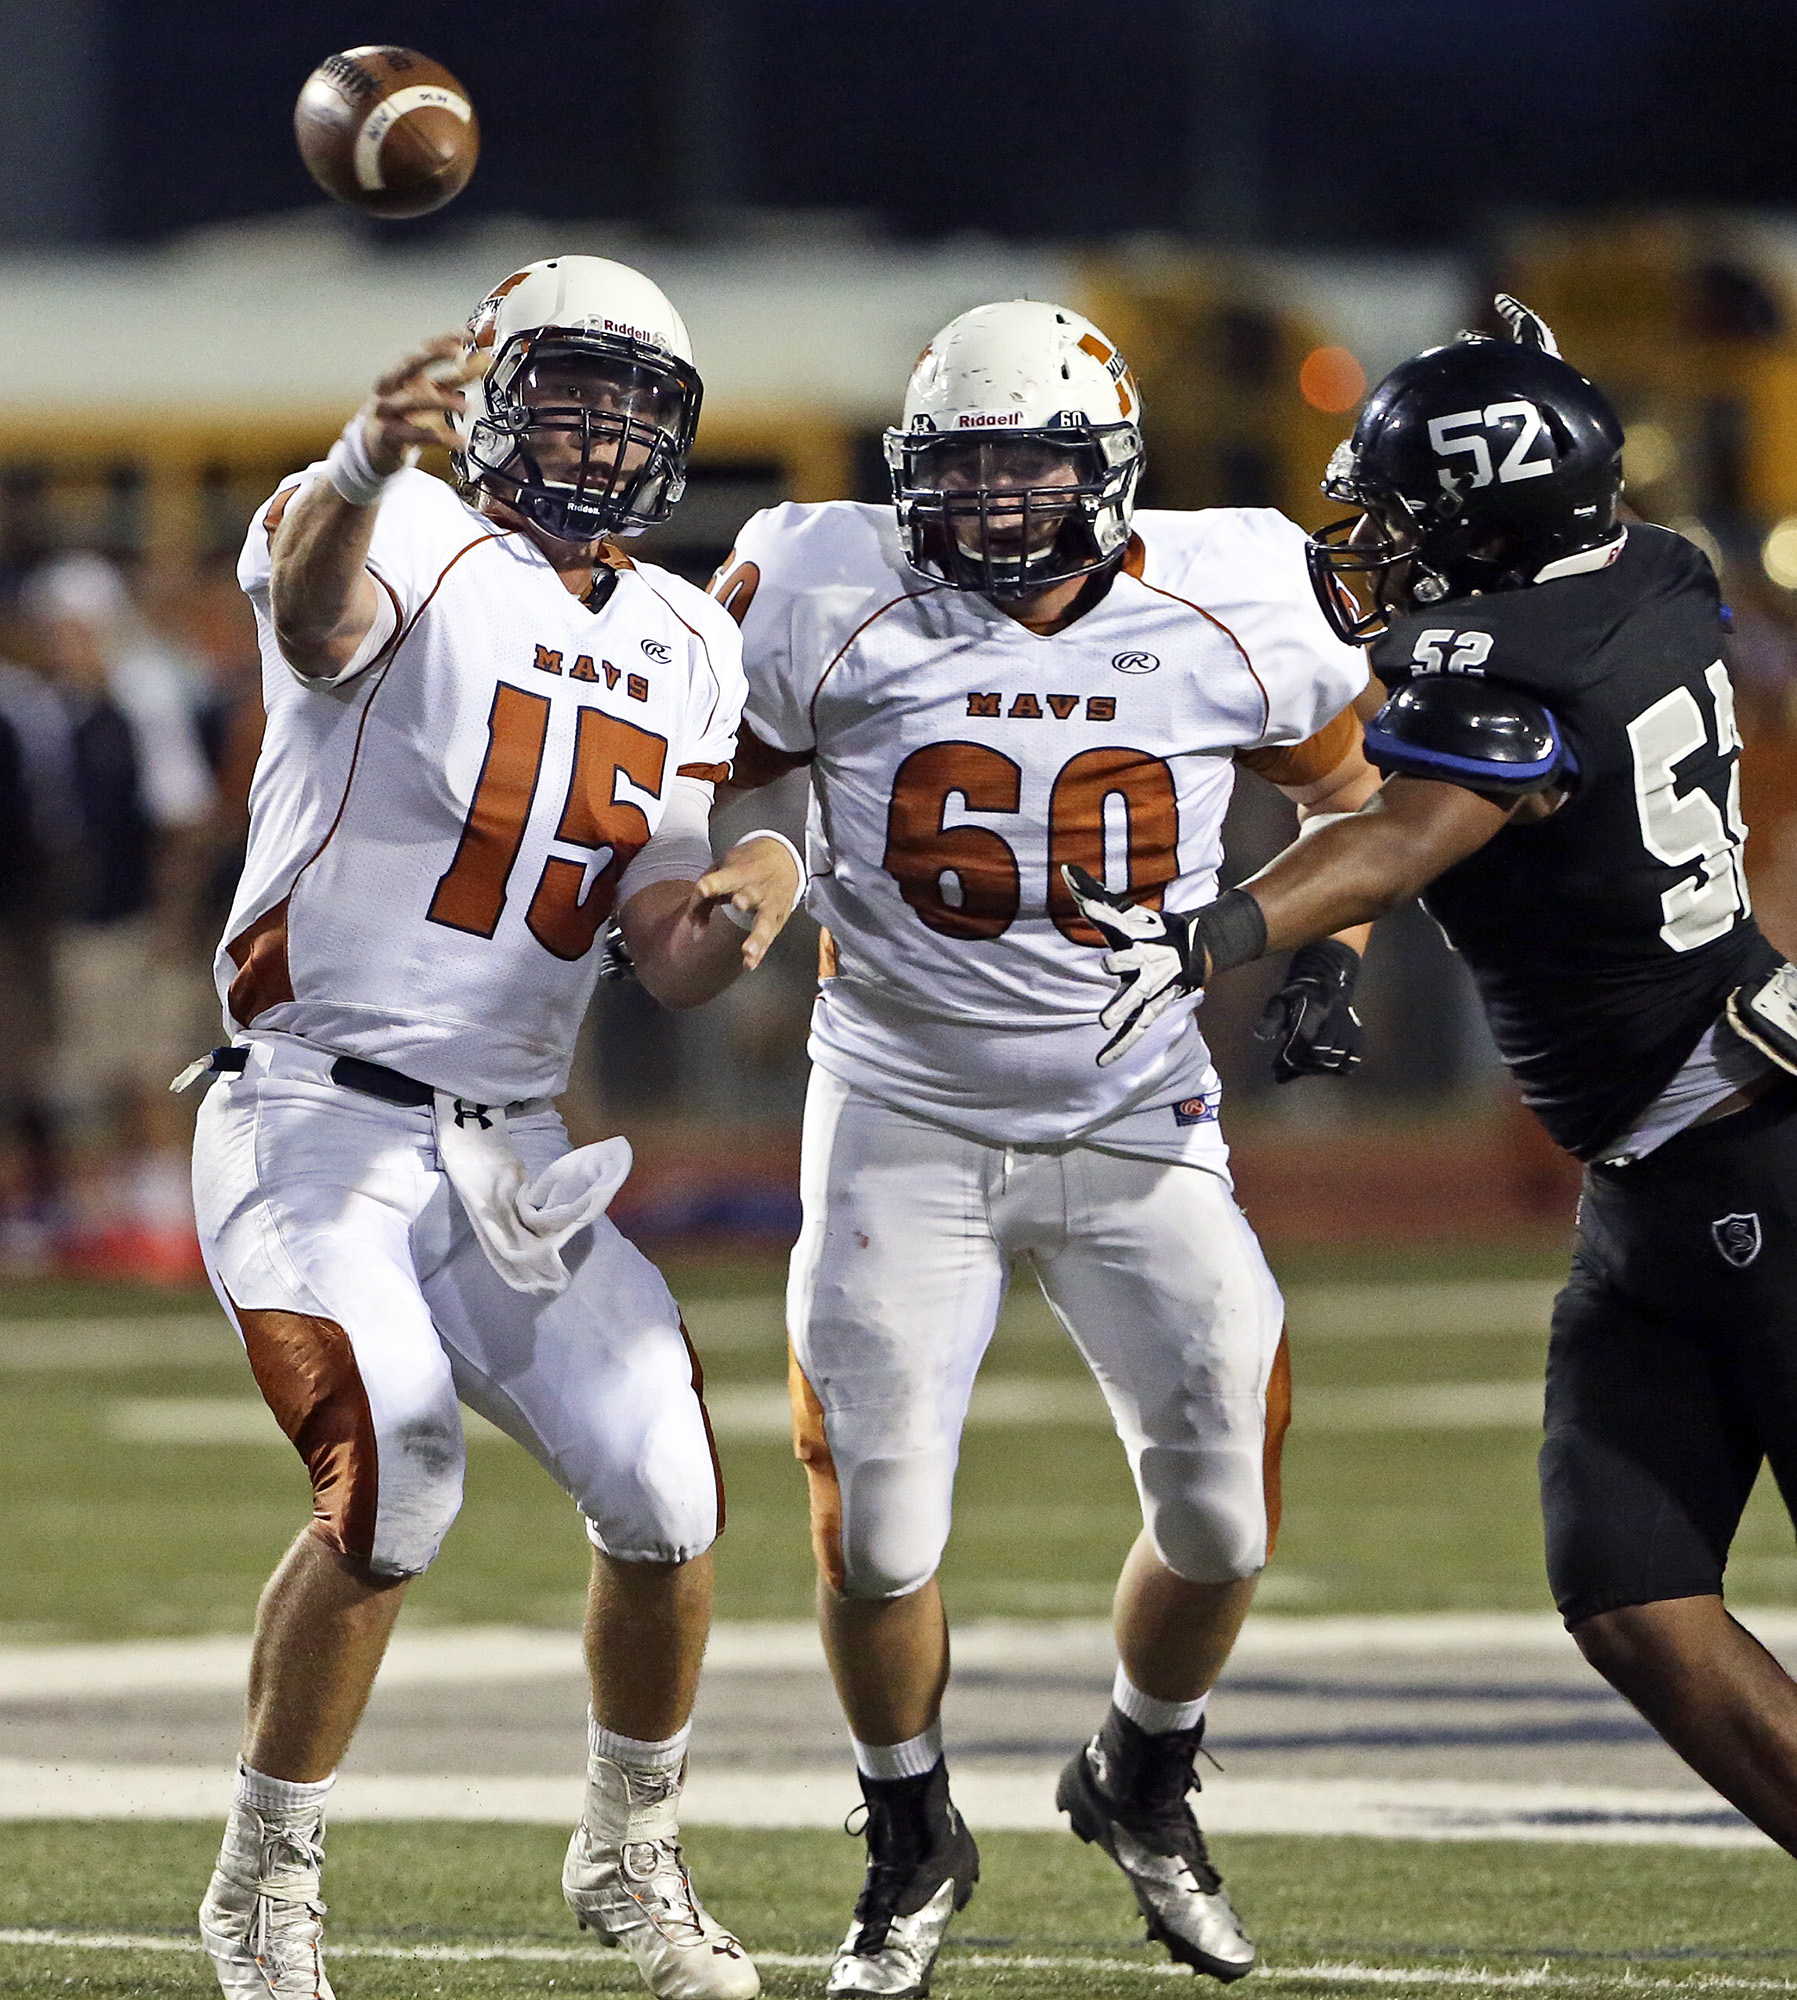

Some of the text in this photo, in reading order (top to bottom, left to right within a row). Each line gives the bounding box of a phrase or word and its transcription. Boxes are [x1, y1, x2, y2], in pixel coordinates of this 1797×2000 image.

[604, 319, 649, 342] Riddell
[959, 413, 1018, 428] Riddell
[1060, 411, 1082, 427] 60
[1428, 400, 1553, 490] 52
[533, 643, 649, 703] MAVS
[1411, 629, 1494, 677] 52
[966, 692, 1117, 722] MAVS
[425, 680, 669, 962] 15
[882, 740, 1181, 948] 60
